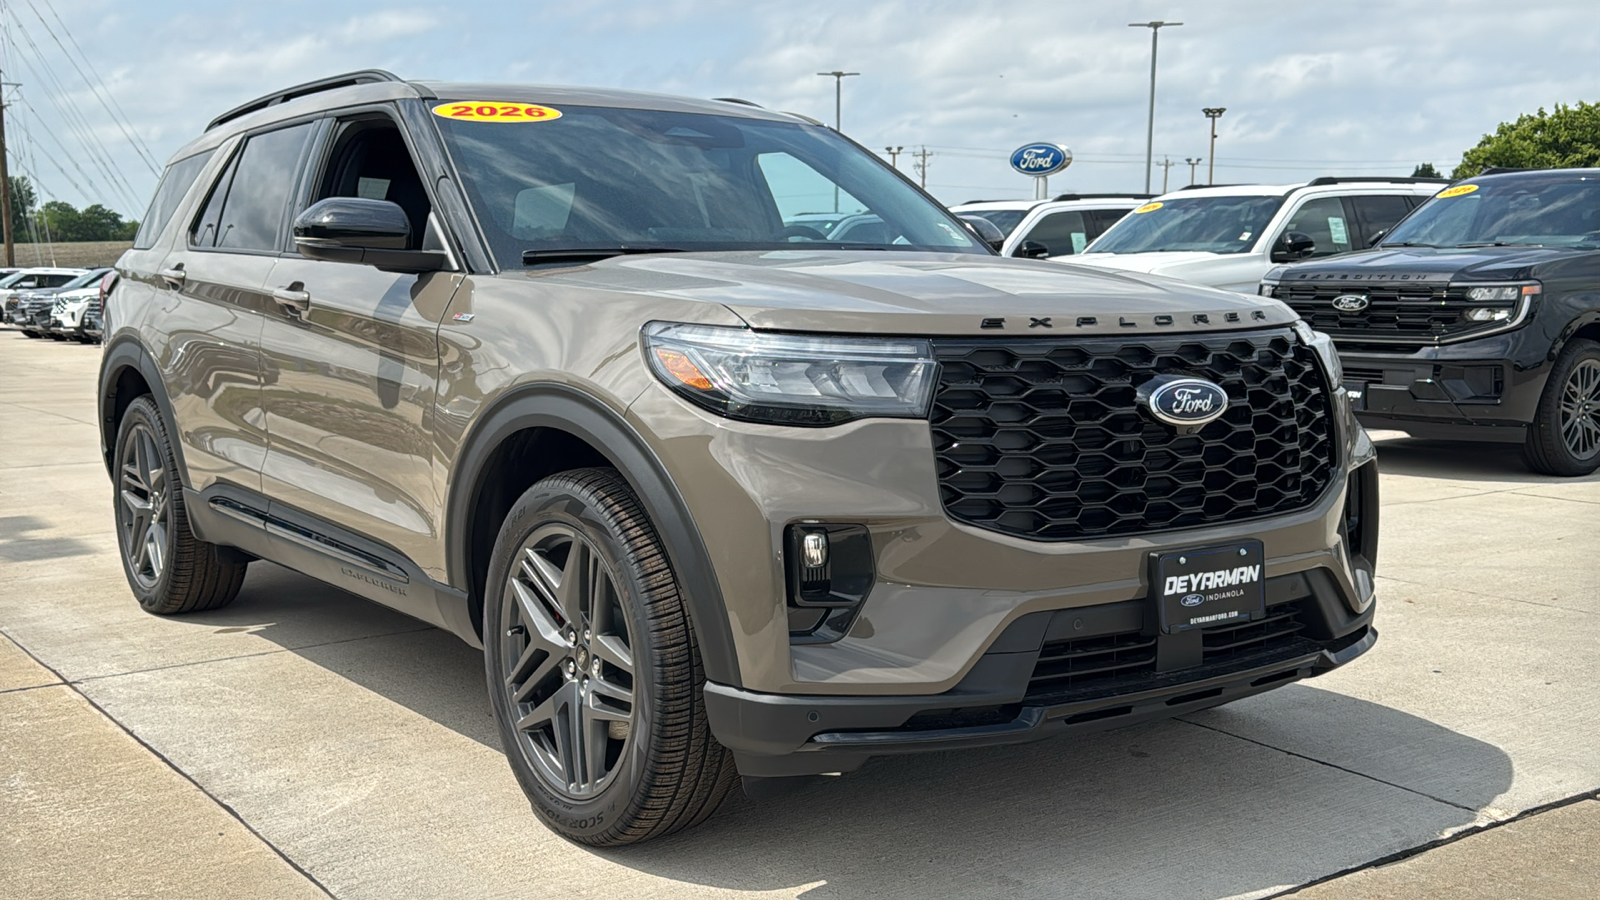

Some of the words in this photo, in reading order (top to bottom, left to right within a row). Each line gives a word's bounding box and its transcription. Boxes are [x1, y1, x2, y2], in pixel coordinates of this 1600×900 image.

[451, 106, 547, 118] 2026
[1020, 149, 1054, 168] Ford
[1338, 297, 1361, 308] Ford
[980, 310, 1267, 329] EXPLORER
[1172, 388, 1214, 414] Ford
[341, 567, 407, 596] EXPLORER
[1163, 564, 1260, 596] DEYARMAN
[1206, 589, 1244, 602] INDIANOLA
[1190, 610, 1239, 625] DEYARMANFORD.COM
